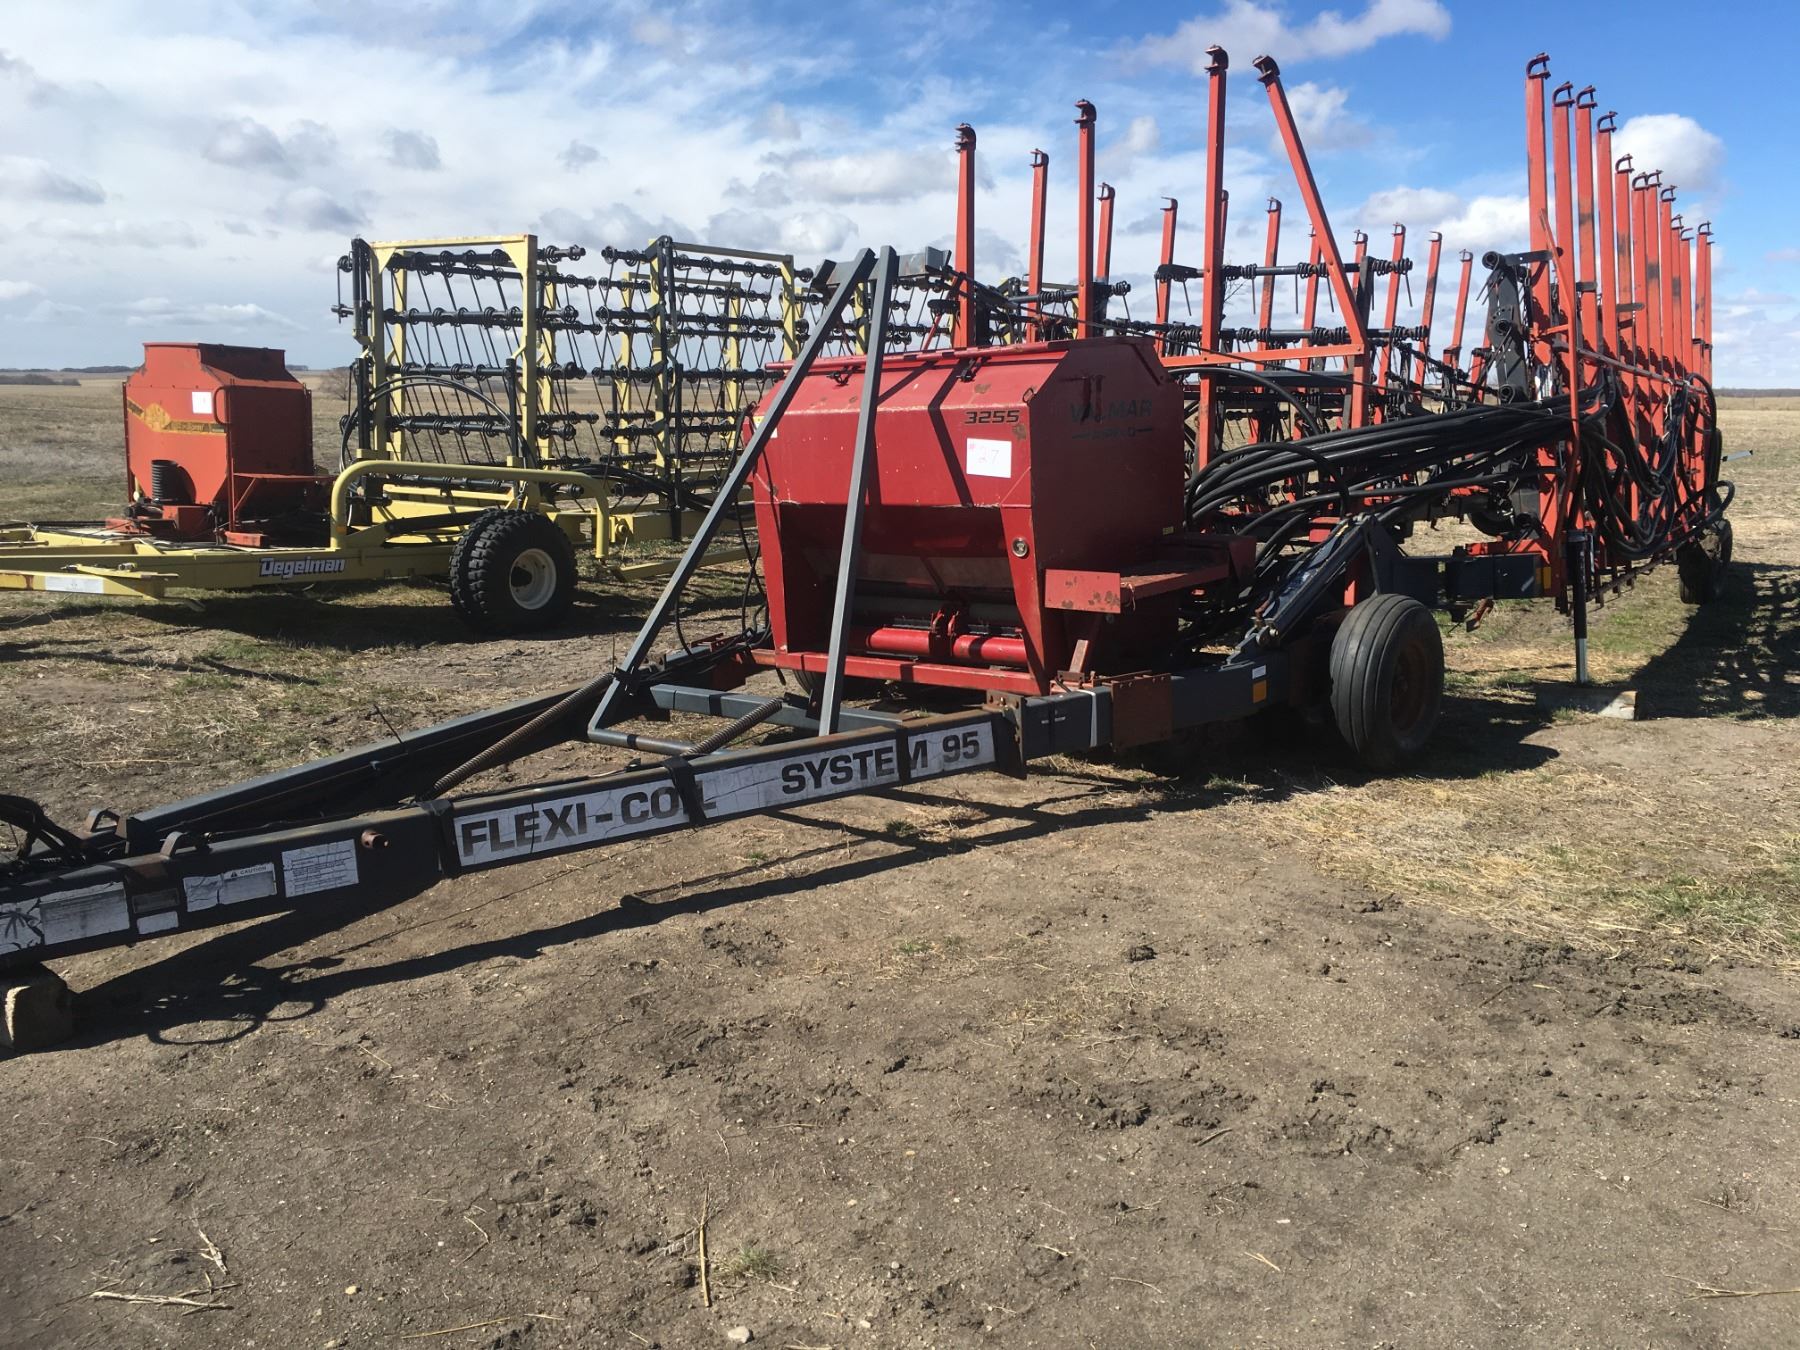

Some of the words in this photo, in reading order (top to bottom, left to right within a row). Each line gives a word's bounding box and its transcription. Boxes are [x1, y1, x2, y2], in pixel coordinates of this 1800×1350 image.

[964, 409, 1020, 424] 3255
[260, 556, 346, 580] Degelman
[461, 781, 717, 858] FLEXI-COL
[781, 739, 929, 795] SYSTEM
[942, 731, 980, 764] 95
[240, 865, 267, 875] CAUTION
